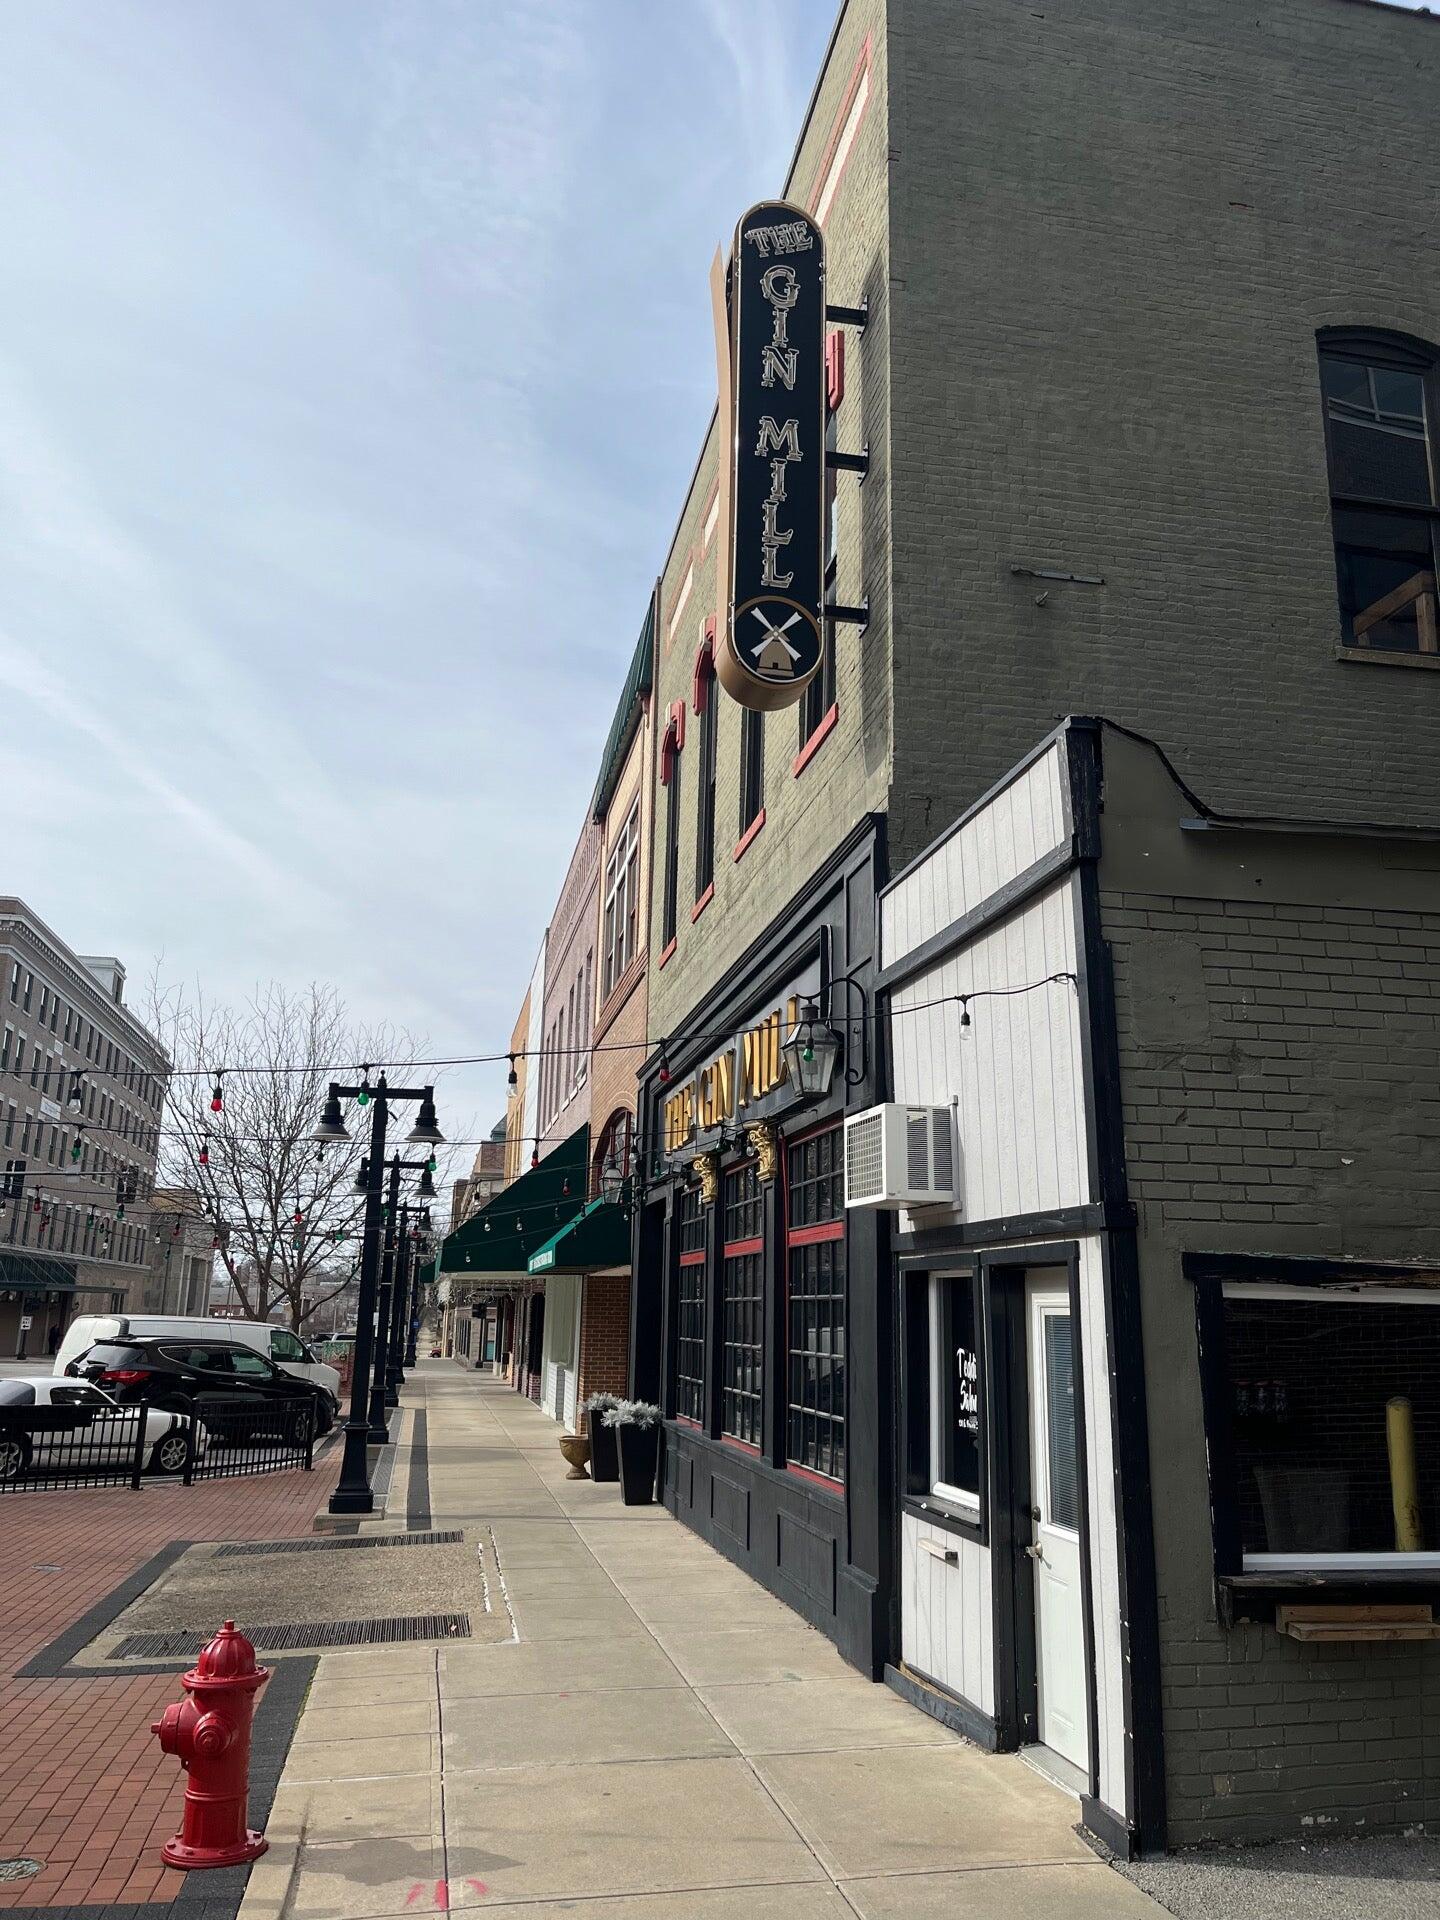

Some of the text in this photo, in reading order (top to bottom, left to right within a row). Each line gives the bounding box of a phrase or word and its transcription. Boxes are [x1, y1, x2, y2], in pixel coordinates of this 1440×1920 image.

[744, 220, 814, 258] THE
[754, 264, 803, 588] GIN MILL
[663, 1080, 696, 1157] THE
[698, 1048, 736, 1134] GIN
